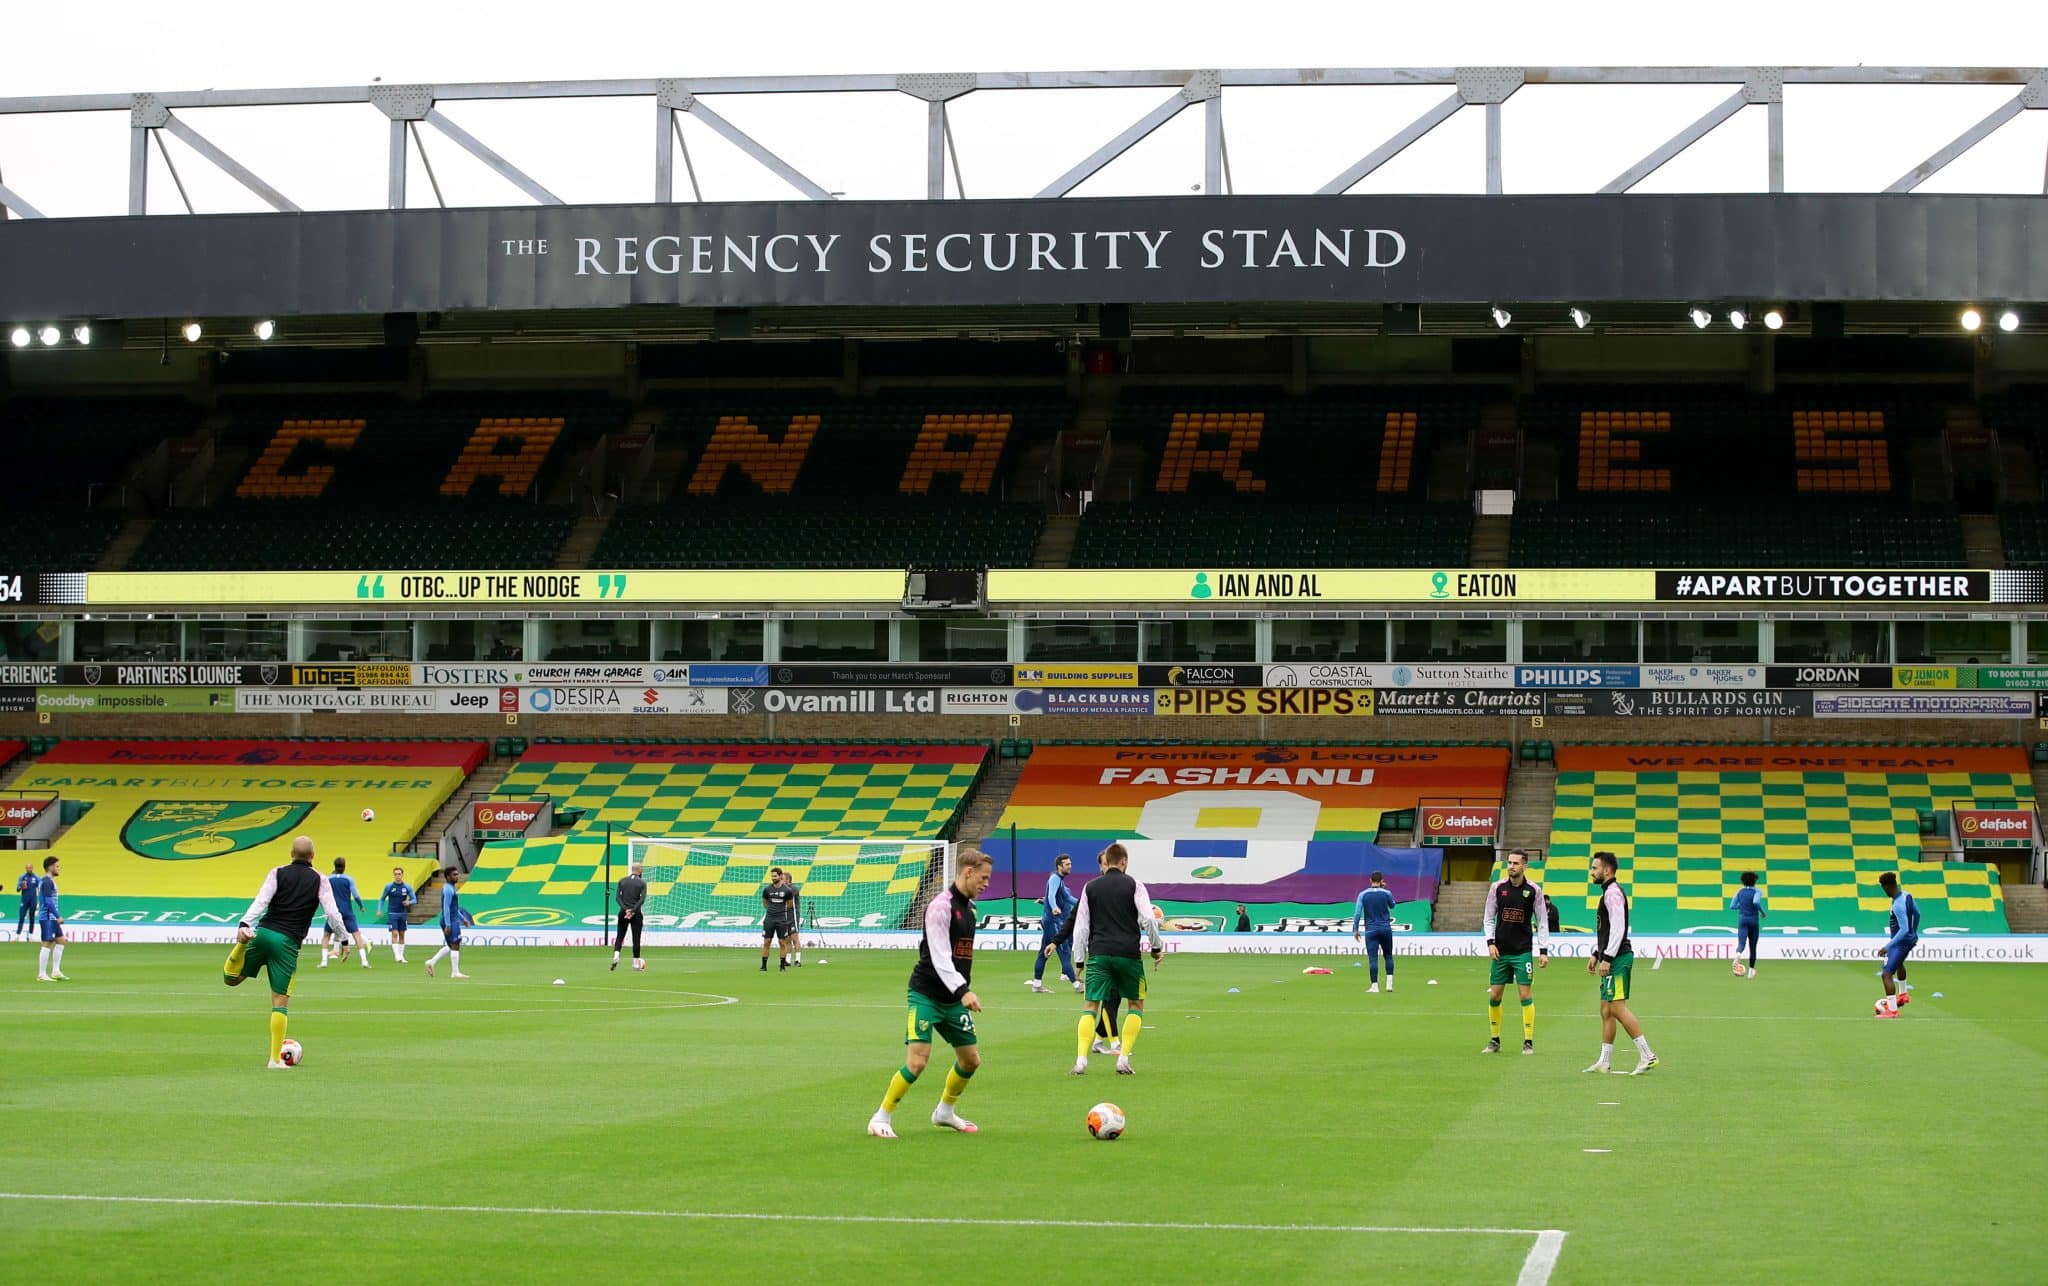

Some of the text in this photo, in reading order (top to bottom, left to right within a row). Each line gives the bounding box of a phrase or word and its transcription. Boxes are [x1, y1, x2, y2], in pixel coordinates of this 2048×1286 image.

[501, 228, 1407, 276] THE REGENCY SECURITY STAND
[486, 576, 518, 599] THE
[523, 576, 581, 599] NODGE
[1218, 574, 1322, 597] IAN AND AL
[1457, 573, 1517, 597] EATON
[1676, 575, 1969, 597] #APARTBUTTOGETHER
[0, 666, 57, 684] ERIENCE
[118, 666, 243, 685] PARTNERS LOUNGE
[423, 665, 508, 686] FOSTERS
[528, 667, 643, 678] CHURCH FARM GARAGE
[832, 671, 852, 680] Thank
[855, 673, 868, 682] you
[870, 672, 877, 680] to
[892, 671, 913, 680] Match
[1018, 670, 1043, 679] MKM
[1047, 672, 1134, 681] BUILDING SUPPLIES
[1187, 668, 1235, 679] FALCON
[1310, 666, 1373, 678] COASTAL
[1417, 666, 1509, 679] Sutton Staithe
[1521, 669, 1602, 686] PHILIPS
[1648, 668, 1673, 676] BAKER
[1706, 668, 1731, 677] BAKER
[1795, 668, 1860, 682] JORDAN
[1914, 670, 1949, 680] JUNIOR
[1310, 679, 1373, 687] CONSTRUCTION
[1655, 674, 1686, 684] HUGHES
[1713, 675, 1743, 685] HUGHES
[38, 694, 168, 709] Goodbye impossible.
[243, 694, 272, 706] THE
[278, 694, 364, 707] MORTGAGE
[370, 694, 433, 707] BUREAU
[450, 693, 489, 709] Jeep
[554, 688, 621, 706] DESIRA
[764, 690, 935, 713] Ovamill Ltd
[947, 693, 1008, 704] RIGHTON
[1048, 694, 1150, 704] BLACKBURNS
[1174, 689, 1354, 715] PIPS SKIPS
[1464, 690, 1541, 706] Chariots
[1652, 692, 1783, 705] BULLARDS GIN
[1837, 697, 1911, 709] SIDEGATE
[1639, 707, 1663, 716] THE
[1669, 707, 1709, 716] SPIRIT
[1715, 707, 1730, 716] OF
[110, 749, 411, 762] Premier League
[613, 749, 926, 758] WE ARE ONE TEAM
[1115, 750, 1440, 764] Premier League
[1627, 757, 1956, 767] WE ARE ONE TEAM
[1098, 767, 1376, 785] FASHANU
[495, 810, 536, 822] dafabe
[1445, 815, 1494, 828] dafabet
[1979, 818, 2028, 831] dafabet
[1655, 944, 1734, 959] MURFIT
[1525, 962, 1533, 974] 8
